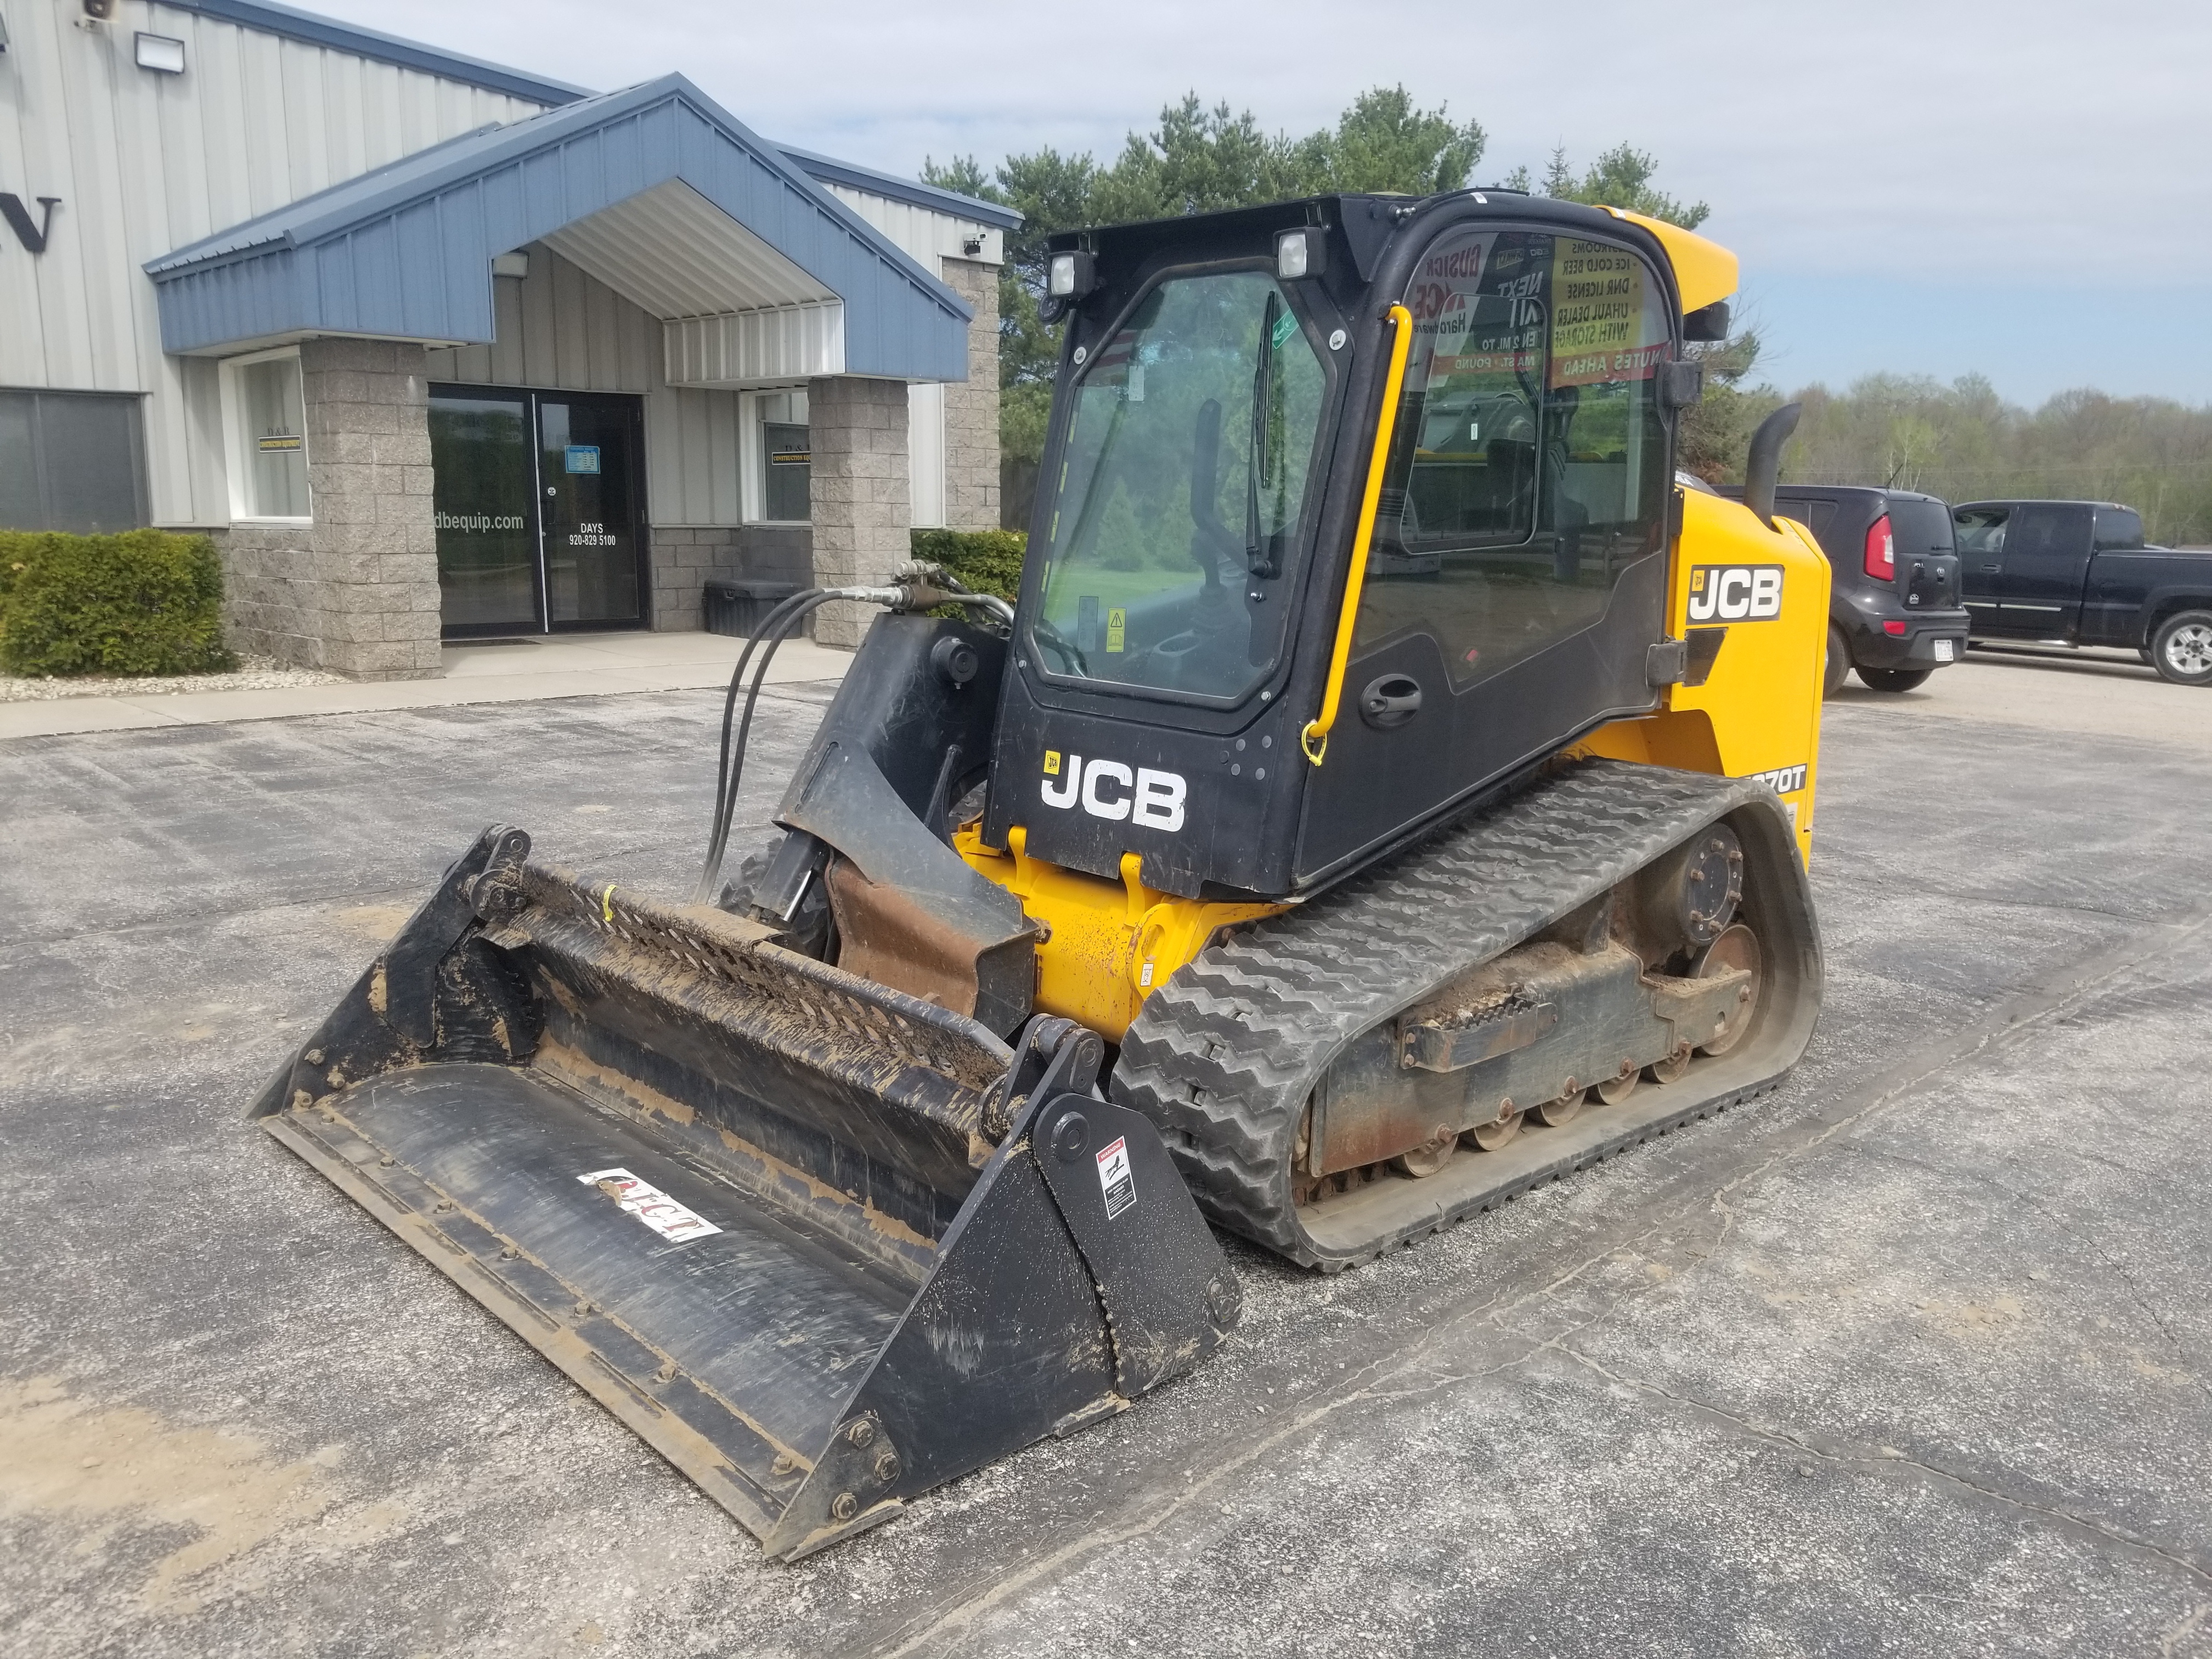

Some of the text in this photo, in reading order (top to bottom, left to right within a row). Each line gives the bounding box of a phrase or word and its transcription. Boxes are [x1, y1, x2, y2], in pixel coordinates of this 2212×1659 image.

[434, 512, 523, 533] dbequip.com
[580, 523, 603, 533] DAYS
[569, 534, 616, 546] 920-829 5100
[1690, 569, 1781, 620] JCB
[1041, 754, 1187, 832] JCB
[1101, 1142, 1121, 1159] WARNING
